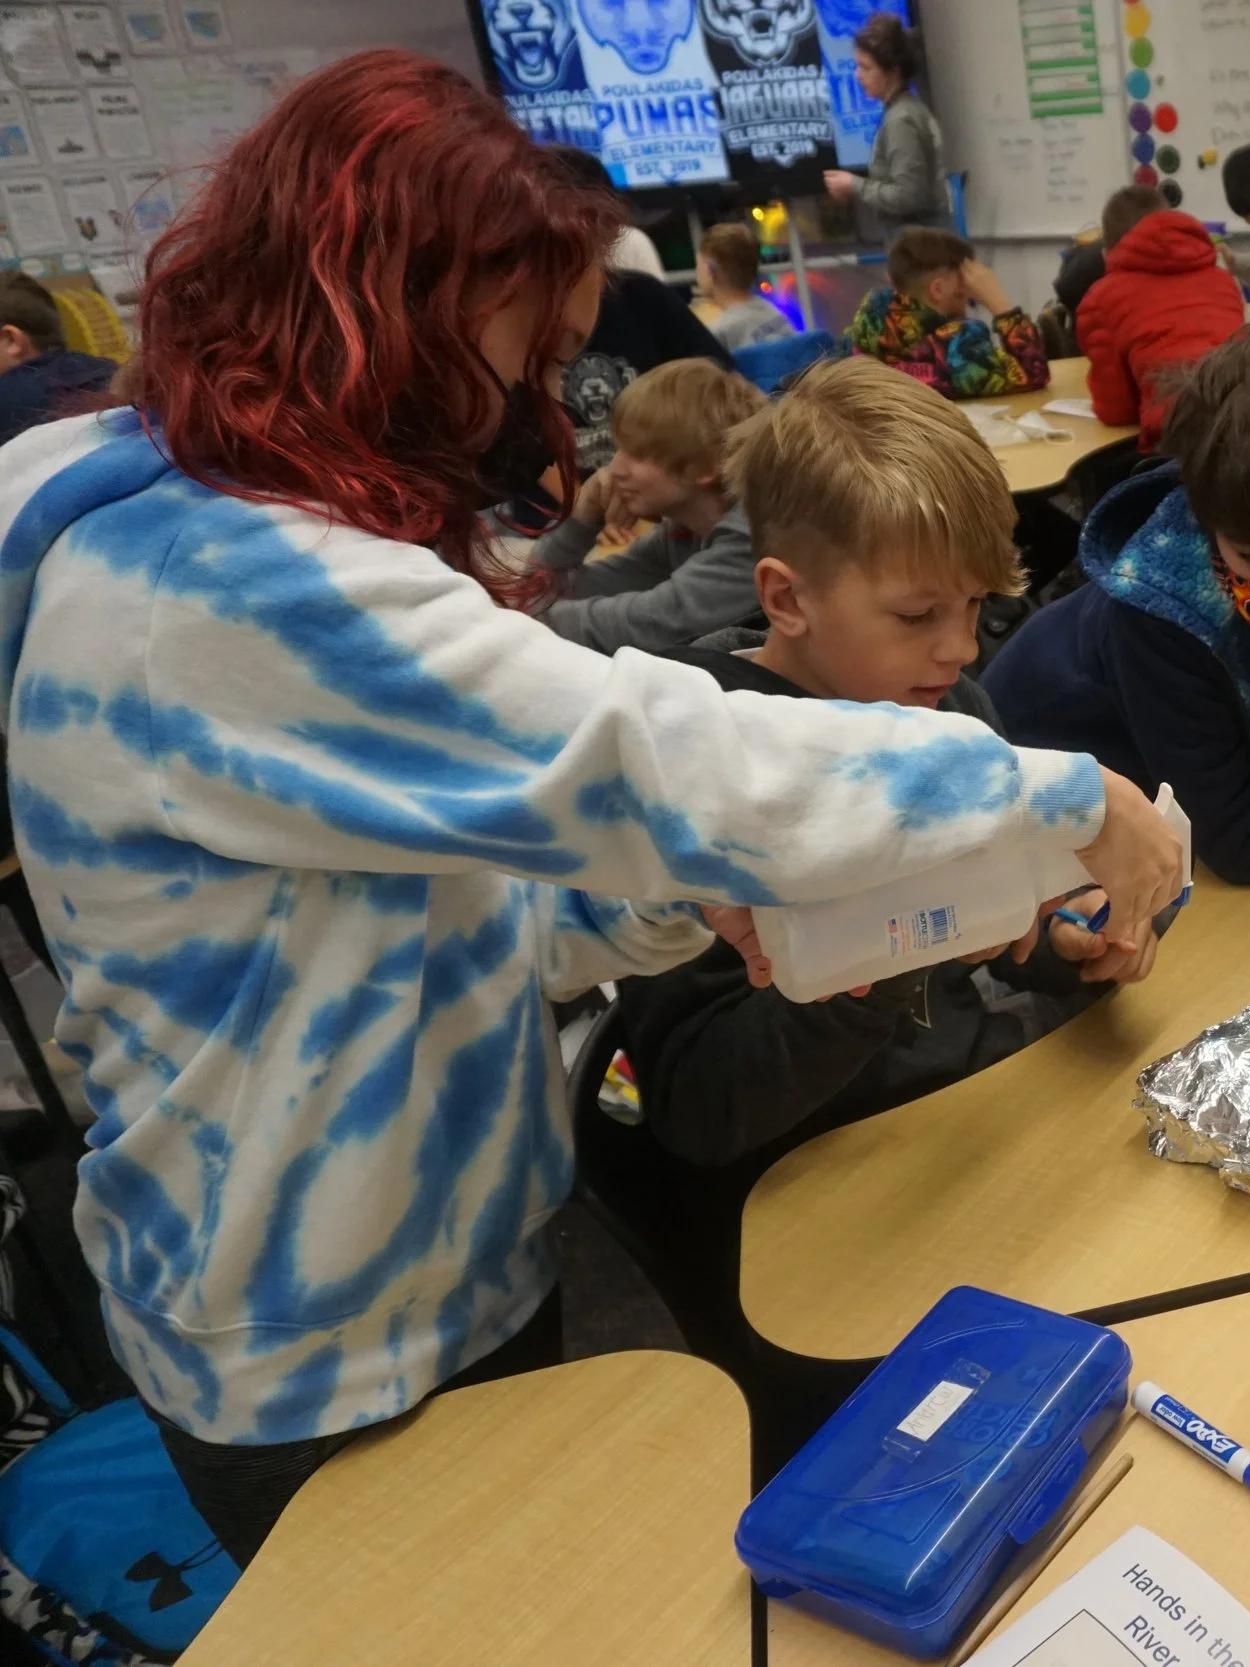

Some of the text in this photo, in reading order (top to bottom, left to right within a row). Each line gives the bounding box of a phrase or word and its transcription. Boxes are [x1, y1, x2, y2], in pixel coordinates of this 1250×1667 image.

[602, 78, 705, 97] POULAKIDAS
[722, 65, 818, 85] POULAKIDAS
[595, 93, 718, 138] PUMAS
[729, 122, 829, 143] ELEMENTARY
[611, 139, 716, 162] ELEMENTARY
[1186, 1419, 1238, 1454] EXPO
[1122, 1563, 1187, 1621] Hands
[1183, 1615, 1208, 1643] in
[1123, 1614, 1181, 1667] River
